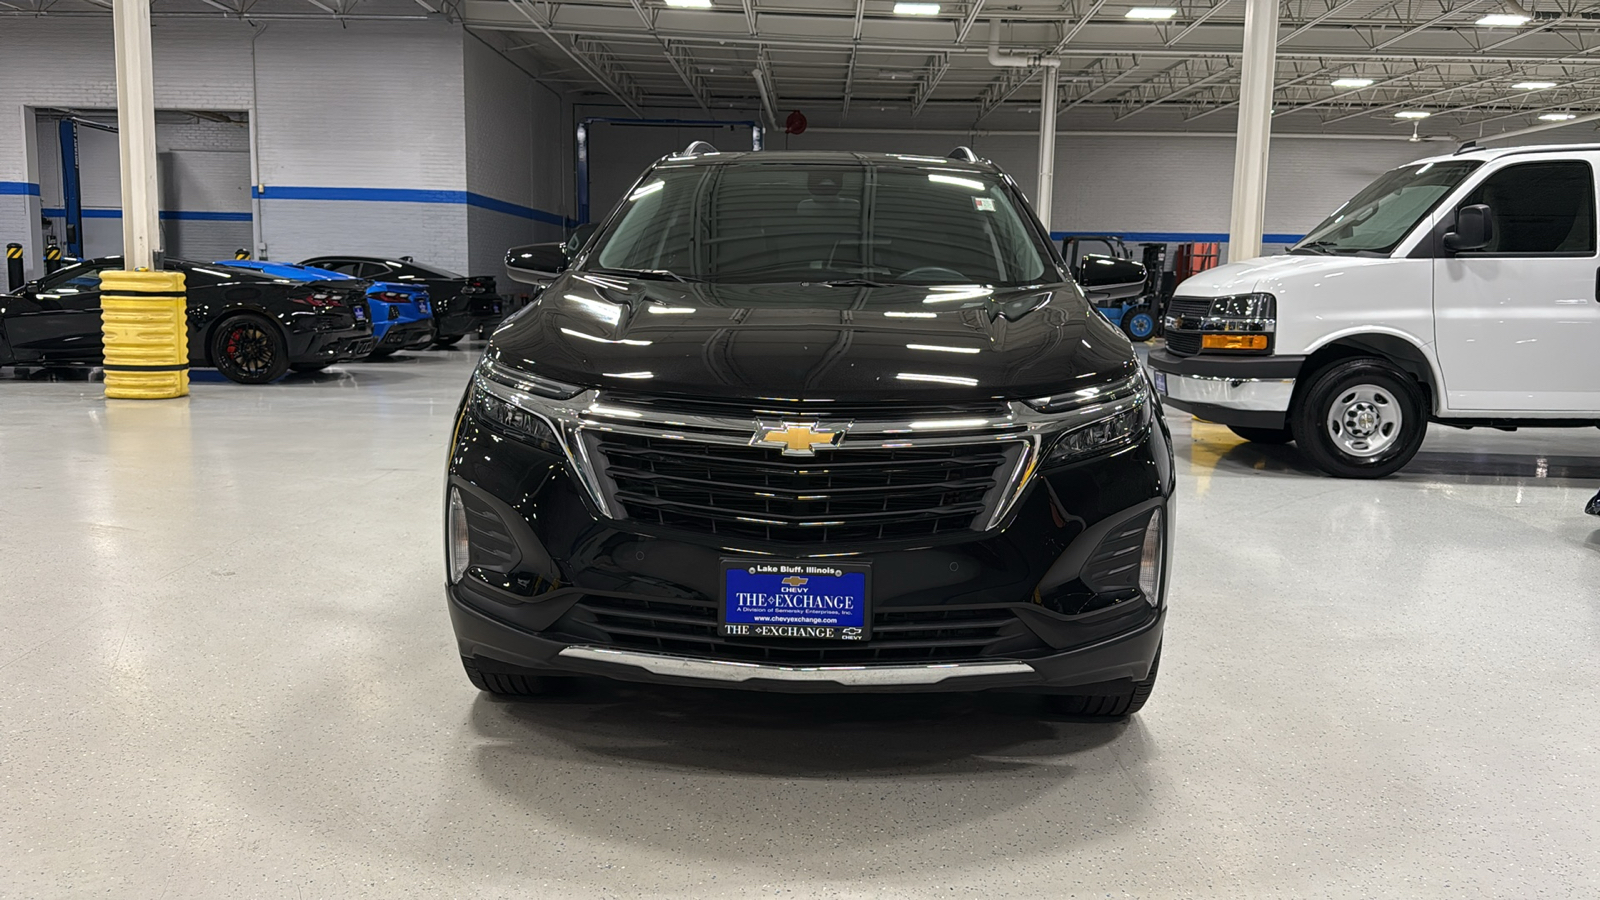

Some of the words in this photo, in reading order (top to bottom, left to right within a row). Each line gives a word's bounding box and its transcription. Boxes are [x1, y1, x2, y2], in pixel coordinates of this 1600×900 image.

[757, 564, 778, 572] Lake
[780, 565, 804, 573] Bluff,
[806, 566, 835, 574] Illinois
[736, 592, 767, 607] THE
[775, 594, 854, 609] EXCHANGE
[754, 616, 837, 624] www.chevyexchange.com
[724, 624, 750, 635] THE
[762, 626, 834, 638] EXCHANGE
